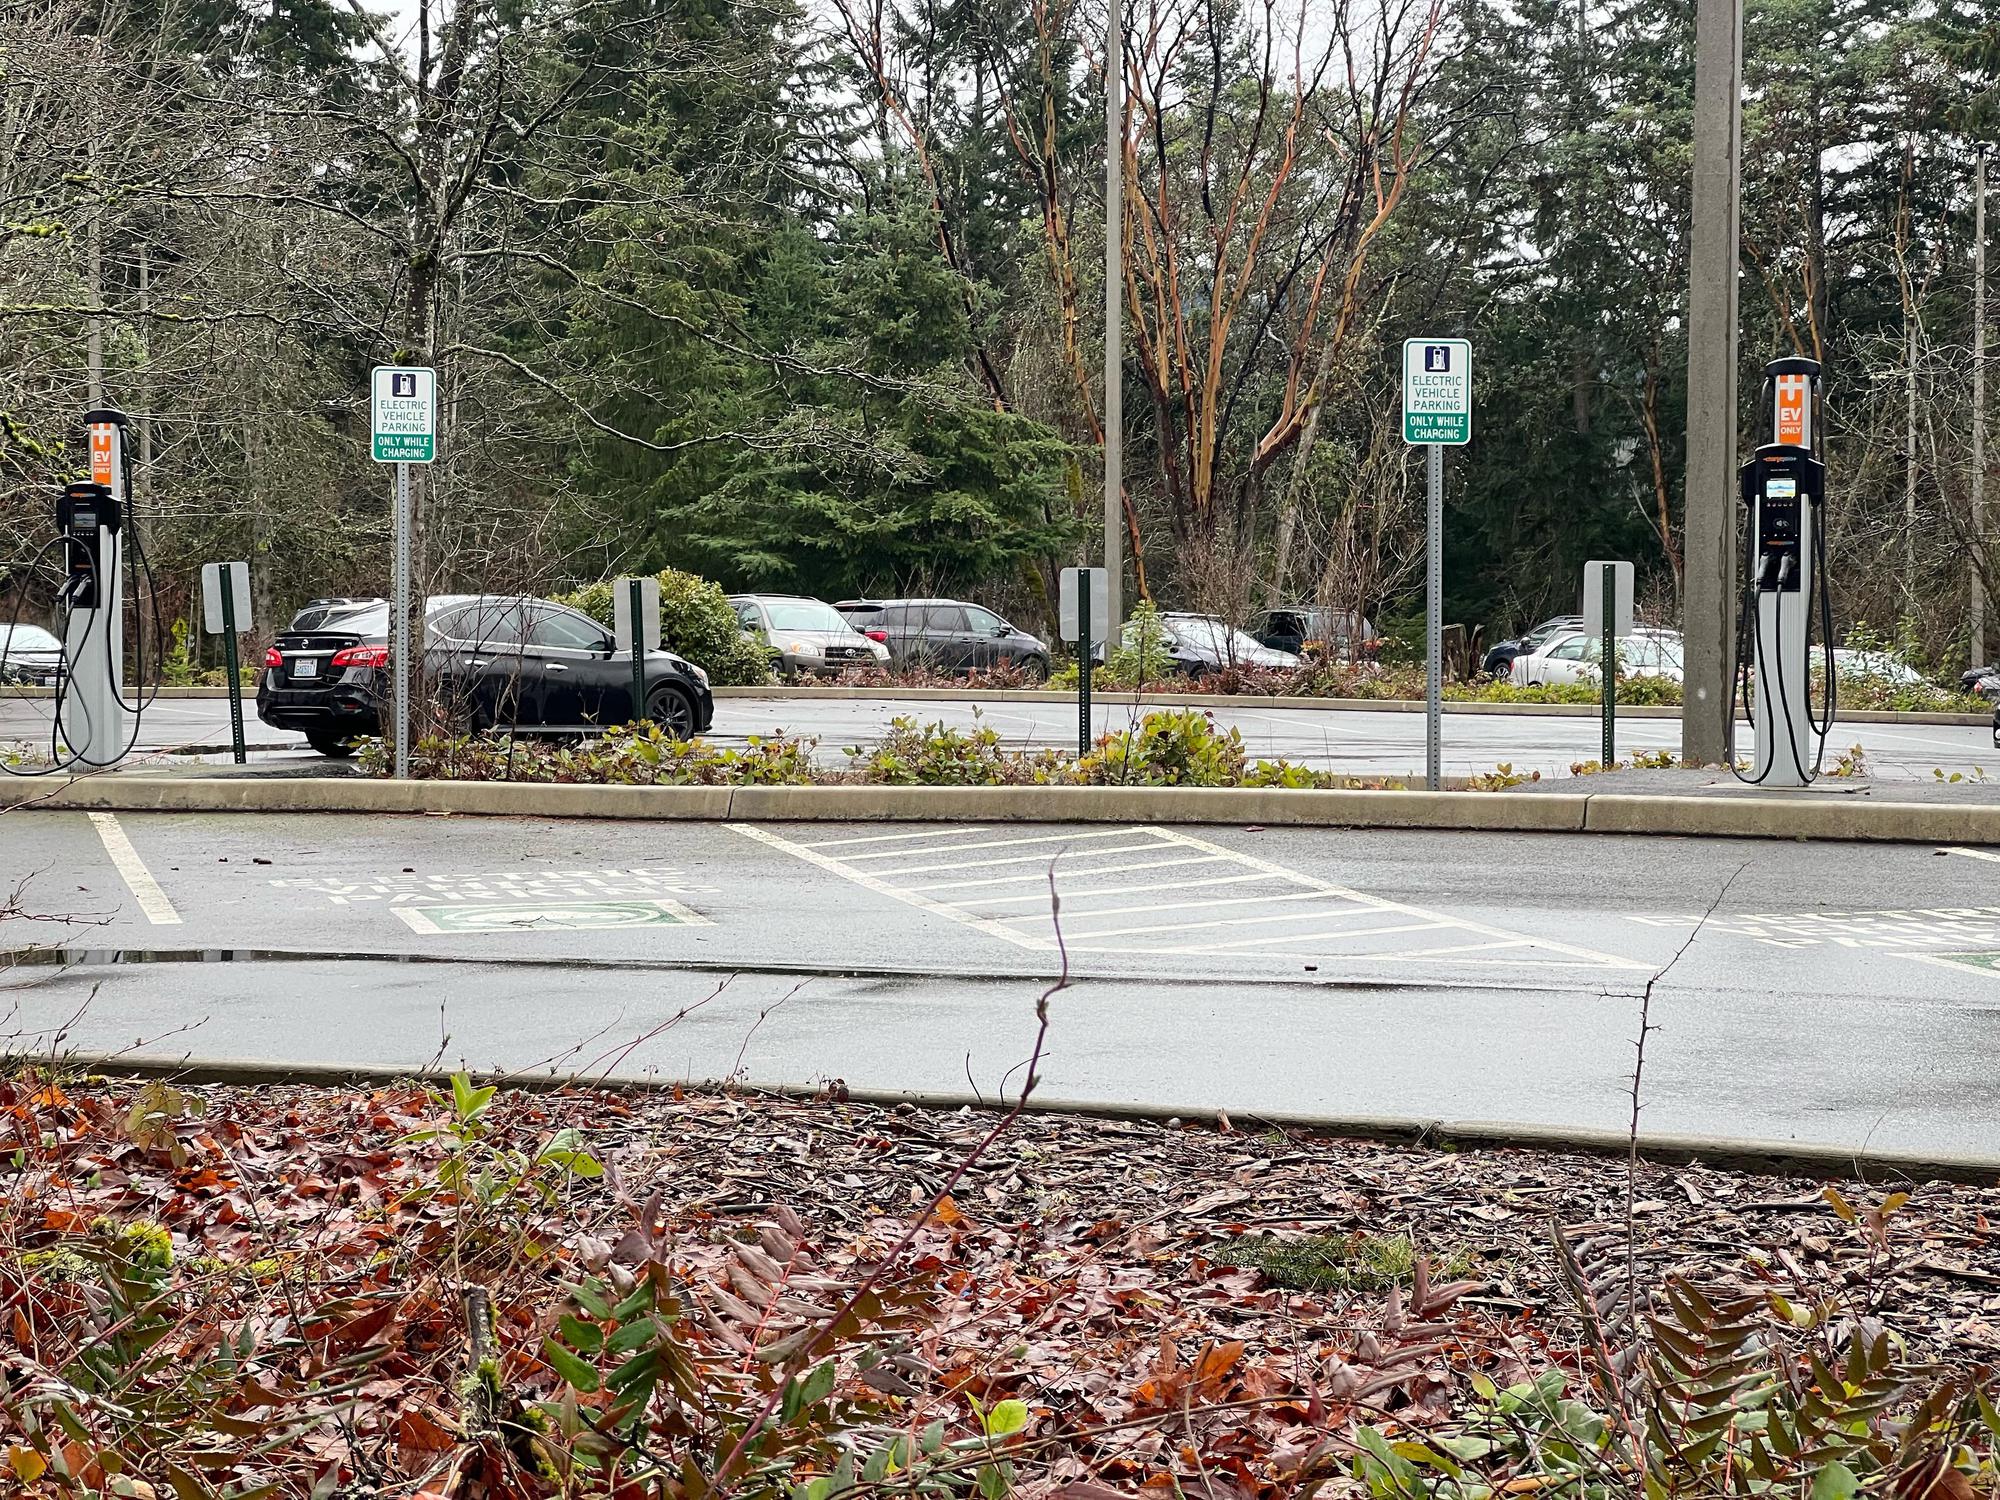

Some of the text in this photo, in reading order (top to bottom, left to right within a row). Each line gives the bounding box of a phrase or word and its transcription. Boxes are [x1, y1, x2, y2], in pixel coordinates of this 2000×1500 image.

[1412, 376, 1462, 386] ELECTRIC
[1415, 388, 1460, 398] VEHICLE
[380, 400, 427, 410] ELECTRIC
[1413, 401, 1461, 411] PARKING
[383, 412, 425, 421] VEHICLE
[1780, 408, 1801, 420] EV
[1410, 416, 1464, 427] ONLY WHILE
[382, 422, 426, 432] PARKING
[1780, 426, 1801, 434] ONLY
[1414, 428, 1460, 439] CHARGING
[378, 436, 429, 447] ONLY WHILE
[94, 451, 110, 463] EV
[382, 448, 425, 458] CHARGING
[268, 867, 688, 888] ELECTRIC
[309, 876, 689, 894] VEHICLE
[327, 885, 725, 904] PARKING
